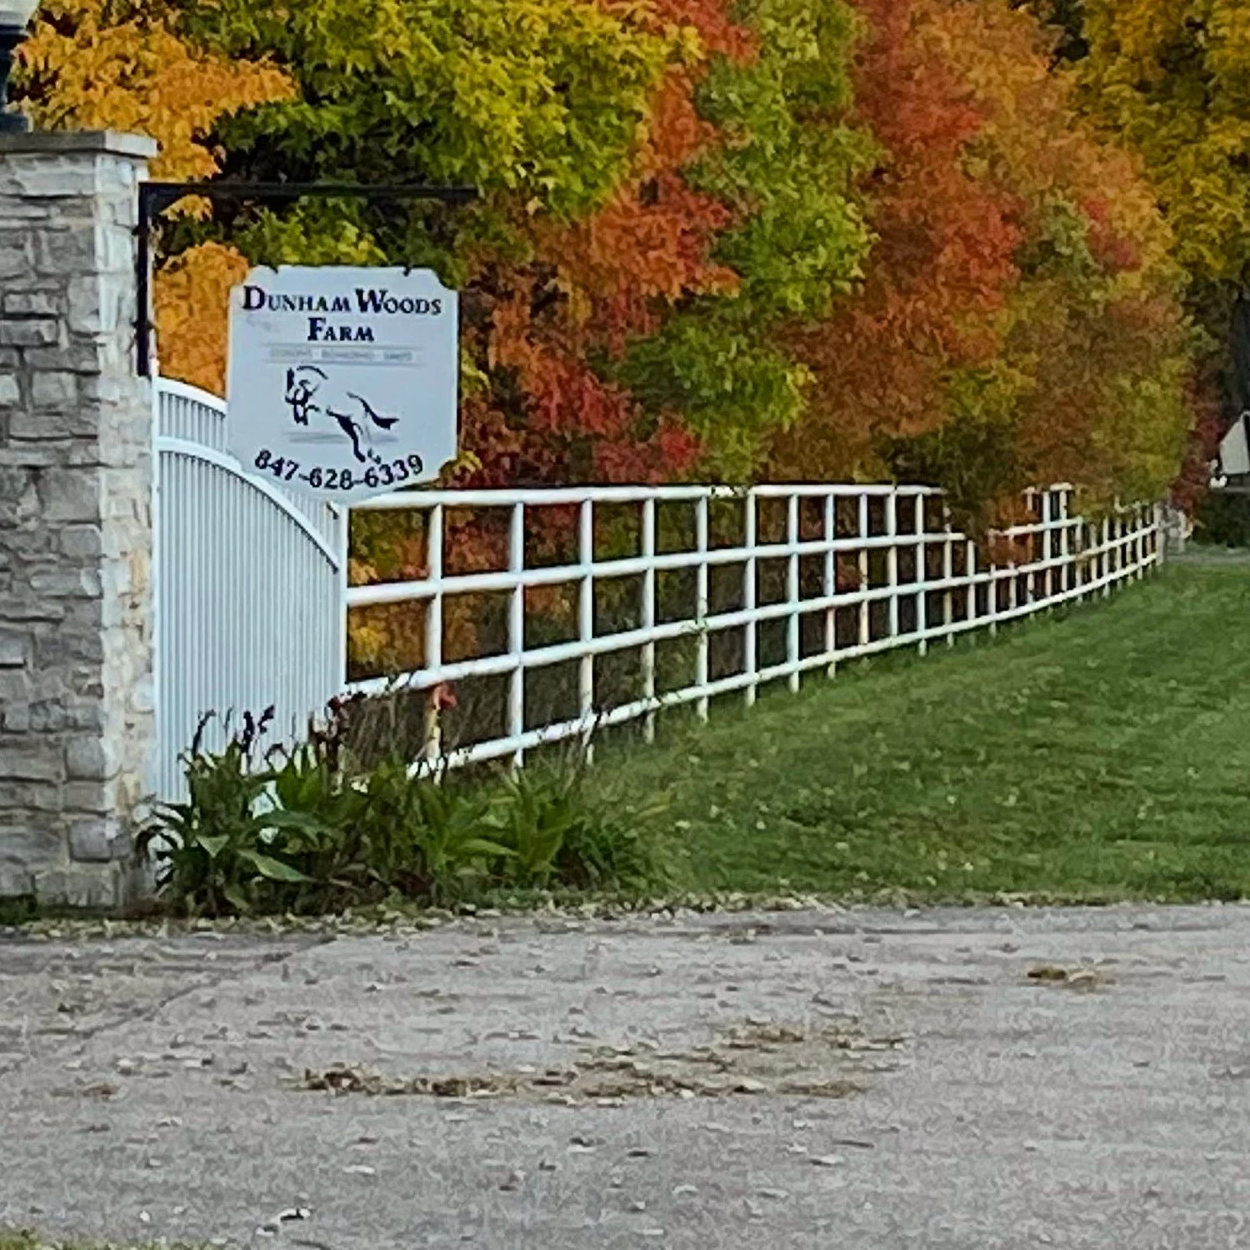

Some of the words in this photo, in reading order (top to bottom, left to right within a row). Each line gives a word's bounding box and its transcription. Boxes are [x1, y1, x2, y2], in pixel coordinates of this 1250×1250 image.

[242, 285, 350, 312] DUNHAM
[355, 288, 442, 315] WOODS
[307, 317, 375, 342] FARM
[254, 449, 423, 490] 847-628-6339
